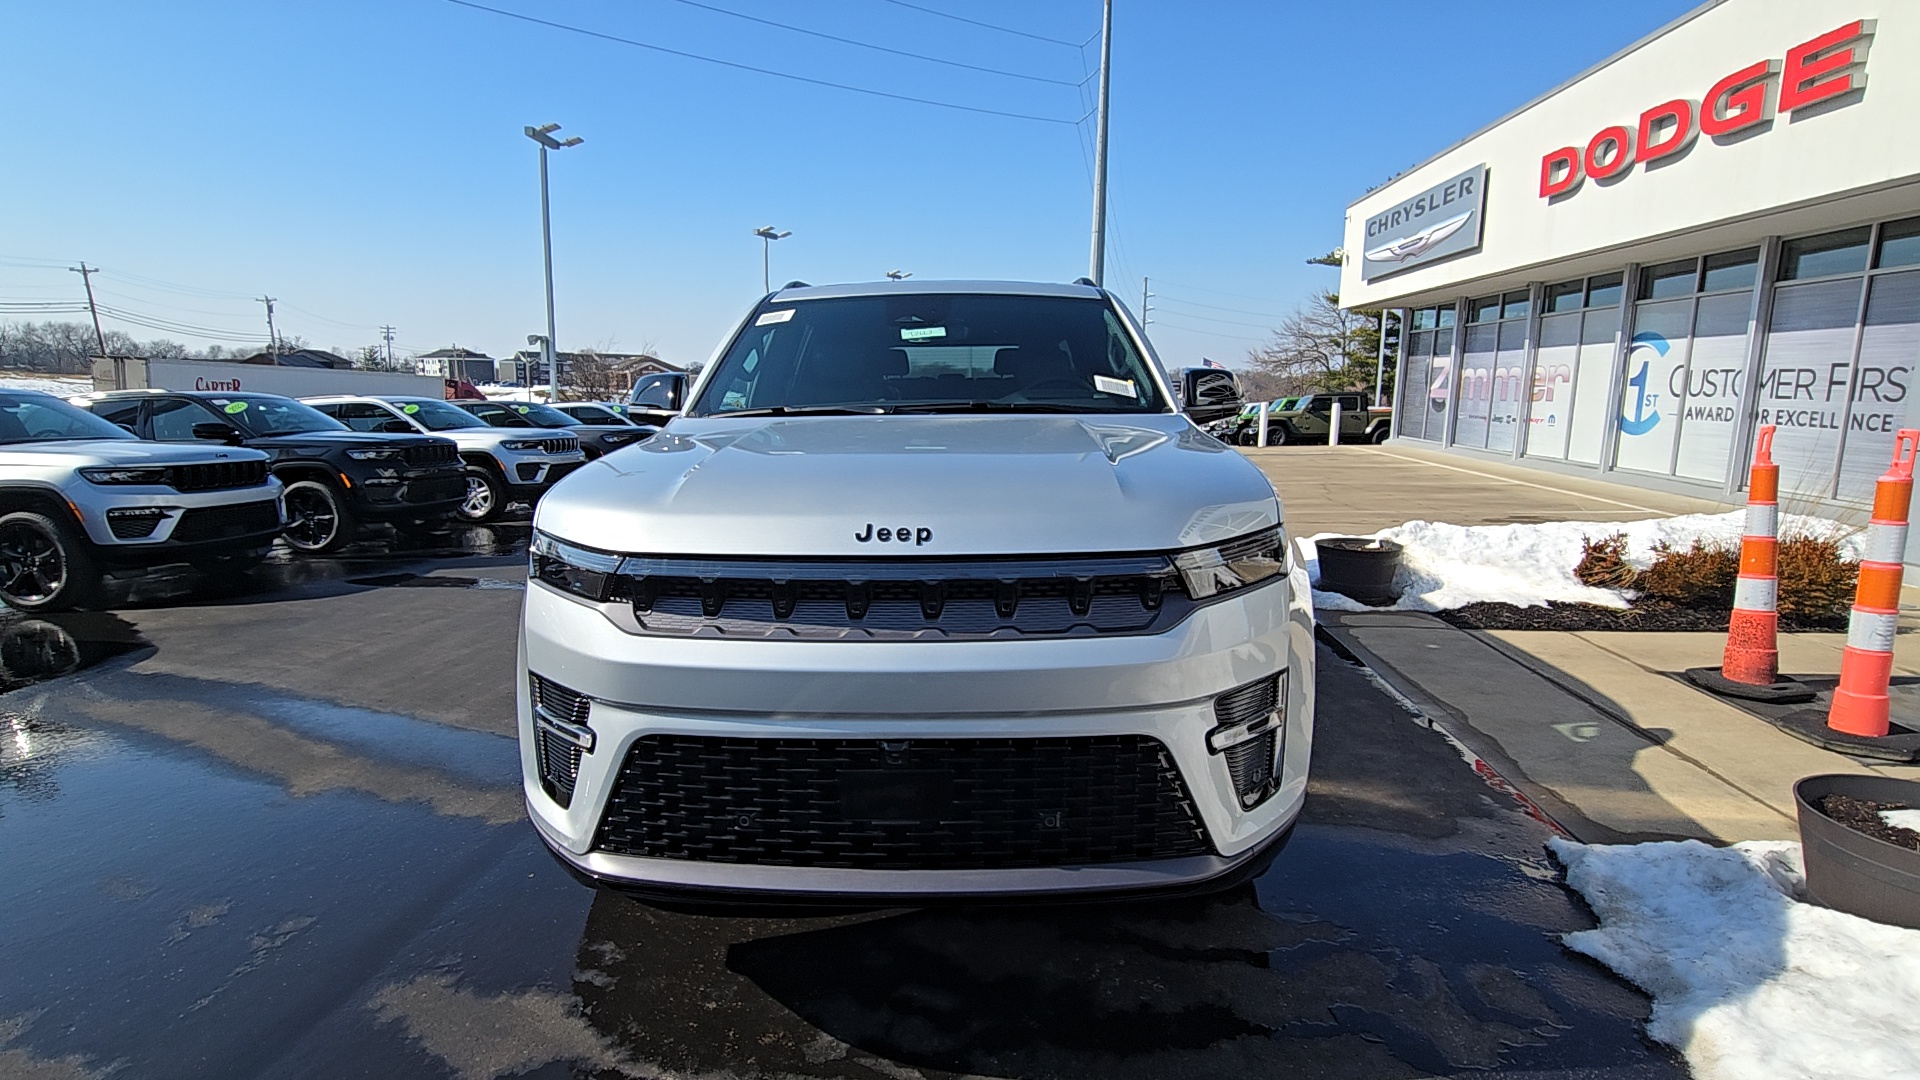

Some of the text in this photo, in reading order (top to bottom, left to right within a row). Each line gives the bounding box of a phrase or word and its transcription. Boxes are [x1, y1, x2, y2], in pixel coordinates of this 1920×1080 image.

[1539, 19, 1877, 199] DODGE
[1367, 176, 1475, 238] CHRYSLER
[195, 376, 241, 392] CARTER
[1429, 357, 1569, 402] Zmmer
[1825, 362, 1915, 402] FIRS
[1684, 406, 1735, 422] AWARD
[1774, 409, 1894, 432] EXCELLNCE
[855, 523, 933, 546] Jeep
